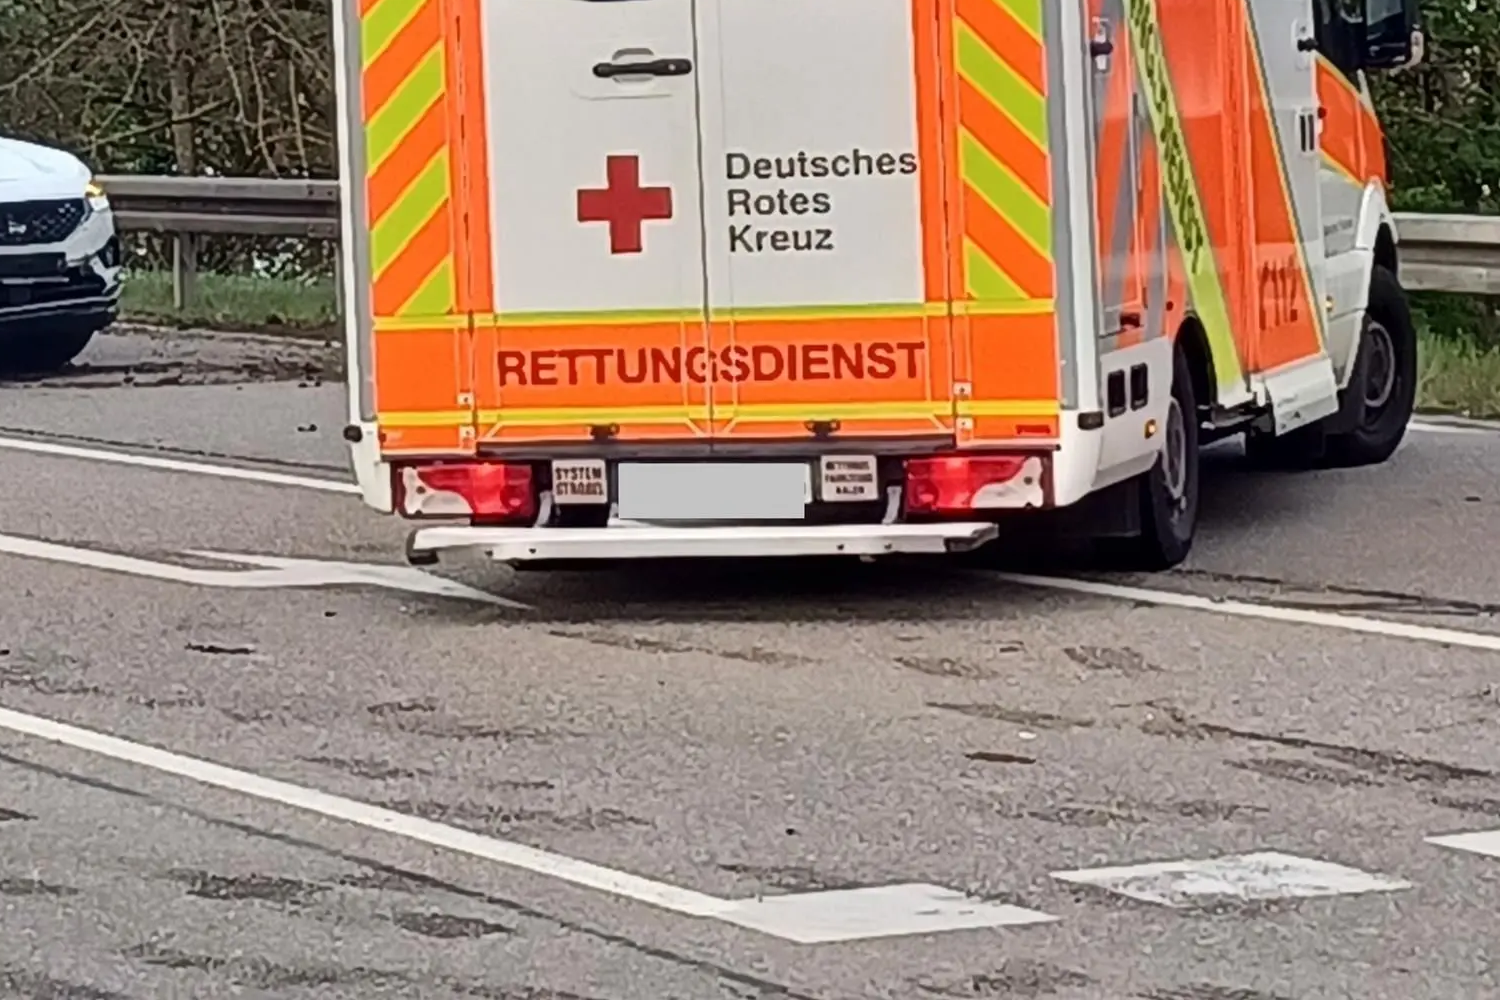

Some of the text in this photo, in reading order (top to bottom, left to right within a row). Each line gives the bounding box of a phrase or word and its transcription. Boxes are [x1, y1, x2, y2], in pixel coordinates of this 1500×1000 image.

[725, 148, 918, 180] Deutsches
[727, 188, 832, 217] Rotes
[728, 224, 835, 253] Kreuz
[497, 341, 926, 387] RETTUNGSDIENST
